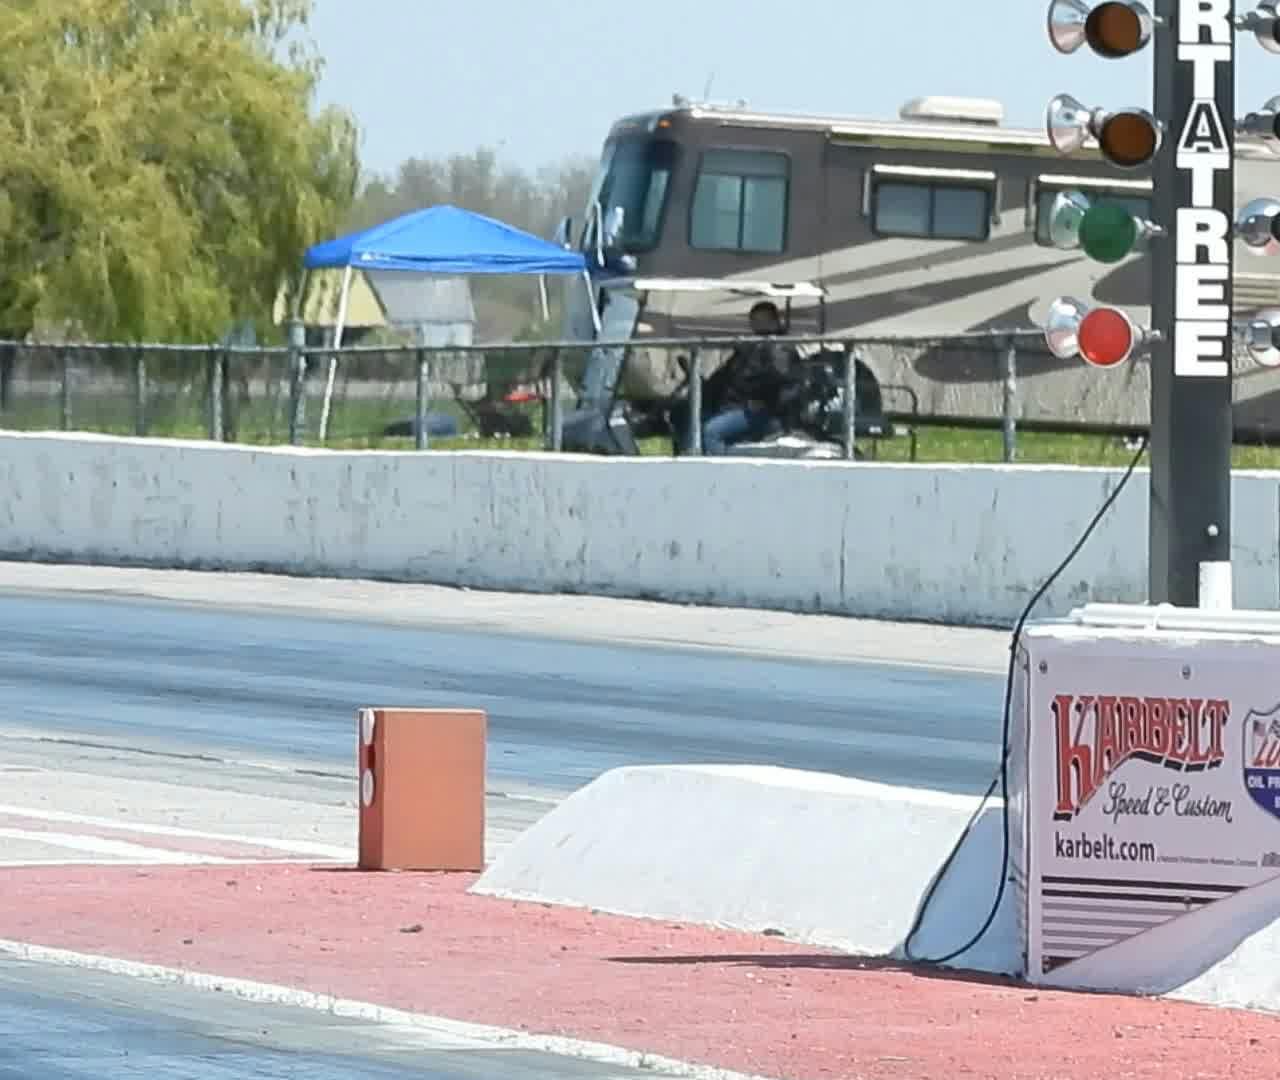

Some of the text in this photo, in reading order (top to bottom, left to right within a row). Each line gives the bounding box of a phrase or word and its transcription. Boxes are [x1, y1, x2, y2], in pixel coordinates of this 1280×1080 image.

[1051, 694, 1232, 823] KARBELT
[1247, 775, 1266, 789] OIL
[1102, 780, 1233, 825] Speed & Custom
[1054, 831, 1155, 863] karbelt.com
